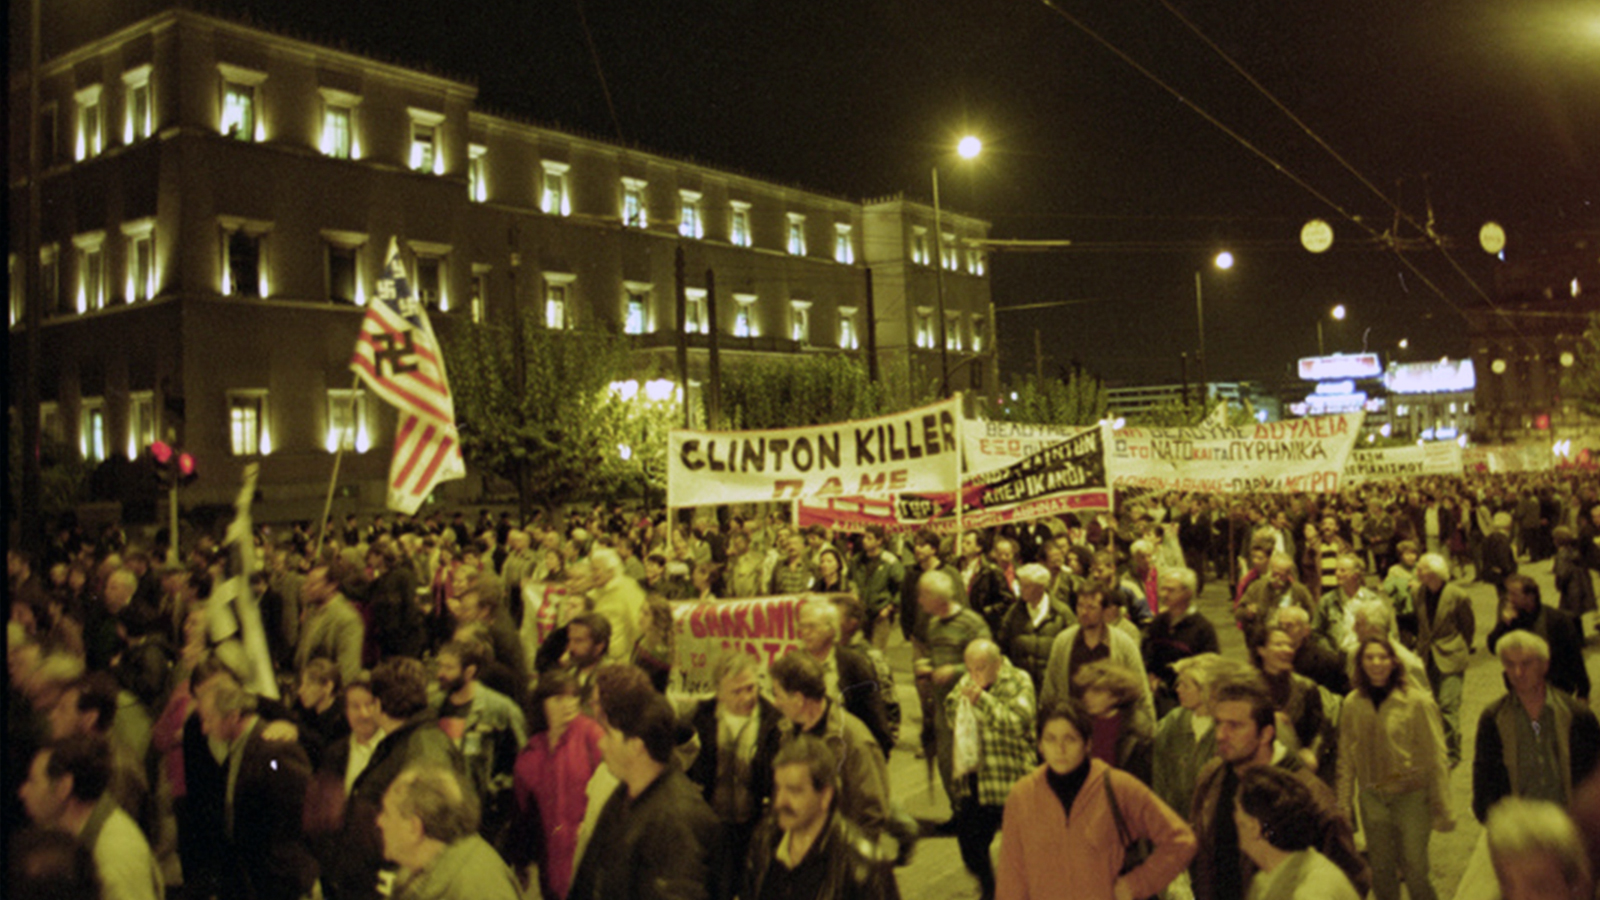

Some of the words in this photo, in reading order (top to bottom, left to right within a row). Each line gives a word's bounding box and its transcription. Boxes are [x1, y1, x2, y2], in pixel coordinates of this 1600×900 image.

[1254, 415, 1349, 439] ΔΟΥΛΕΙΑ
[680, 431, 840, 472] CLINTON
[855, 410, 956, 466] KILLER
[1151, 439, 1193, 460] ΝΑΤΟ
[1230, 440, 1328, 461] ΠΥΡΗΝΙΚΑ
